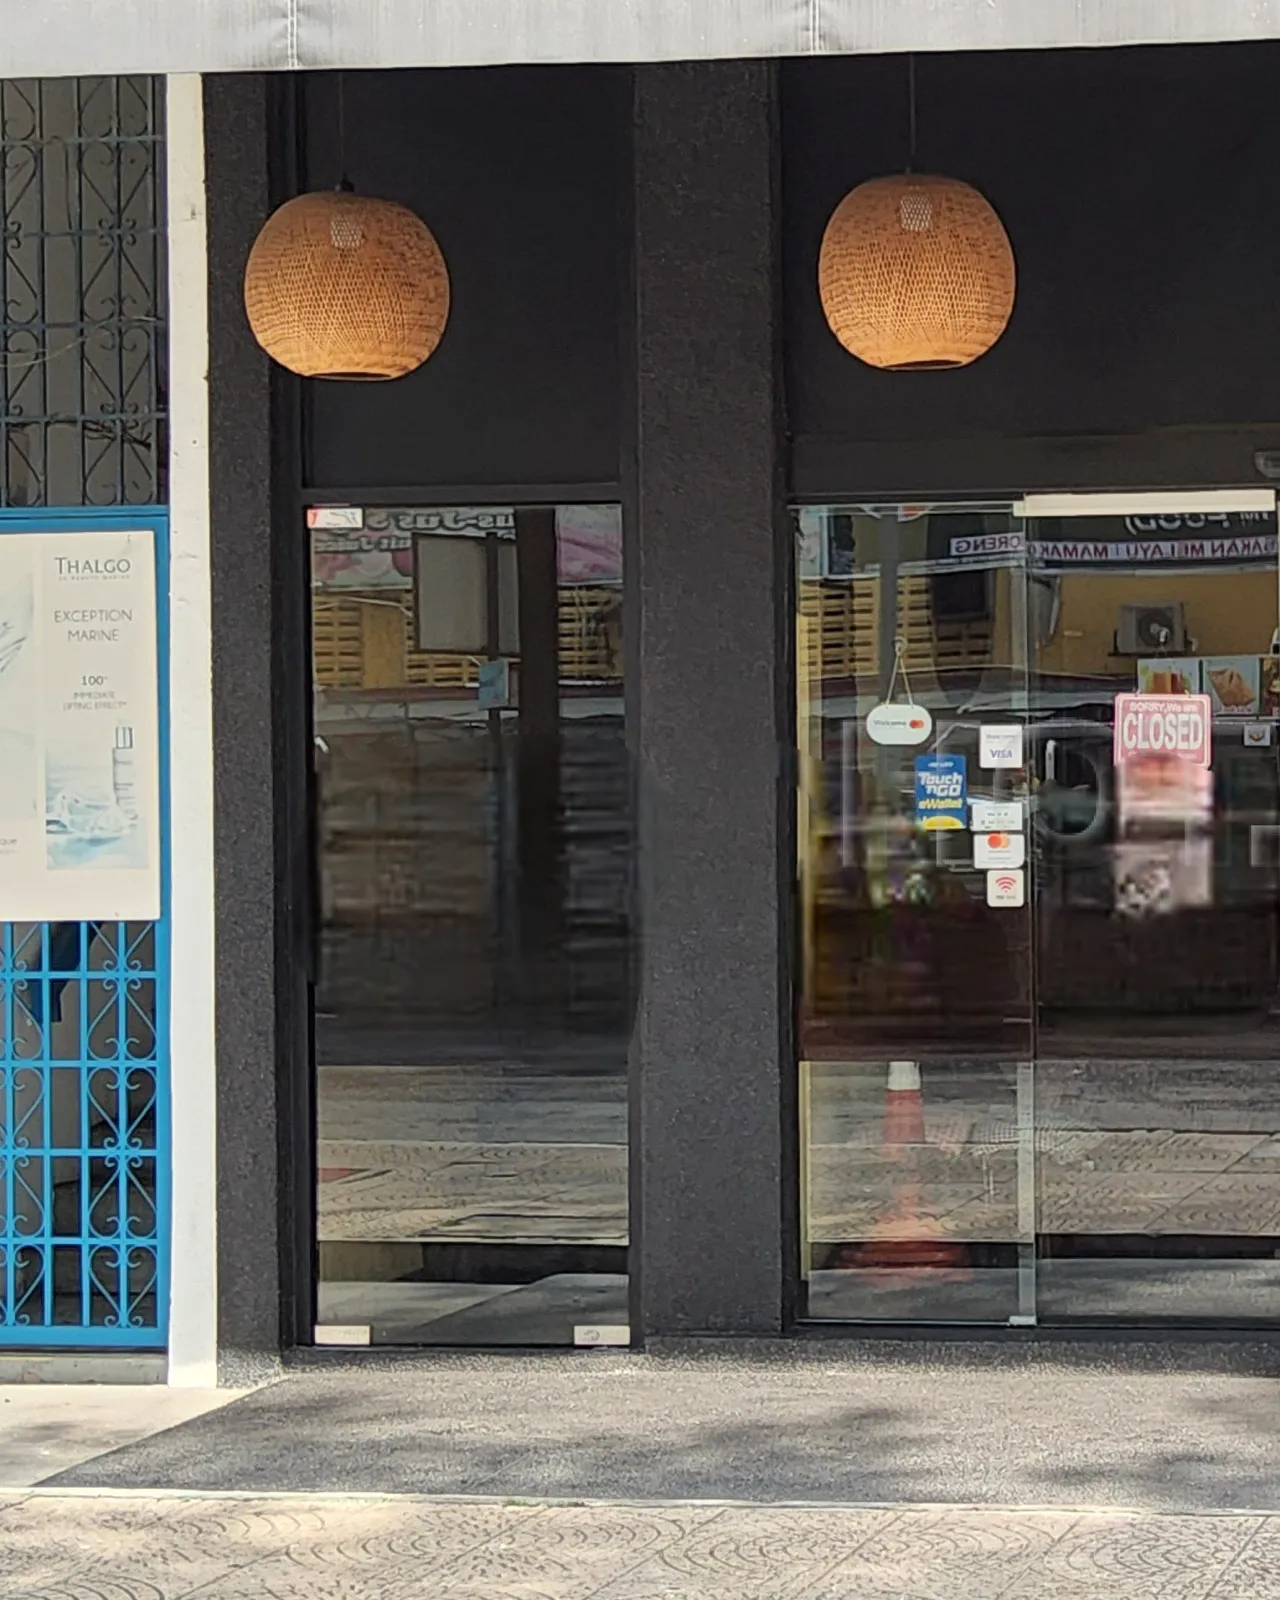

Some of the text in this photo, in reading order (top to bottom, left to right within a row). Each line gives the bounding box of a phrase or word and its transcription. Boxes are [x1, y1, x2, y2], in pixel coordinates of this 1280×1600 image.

[54, 556, 131, 576] THALGO
[54, 609, 133, 623] EXCEPTION
[67, 629, 120, 642] MARINE
[1123, 713, 1203, 750] CLOSED
[990, 748, 1013, 759] VISA
[918, 771, 963, 786] Touch
